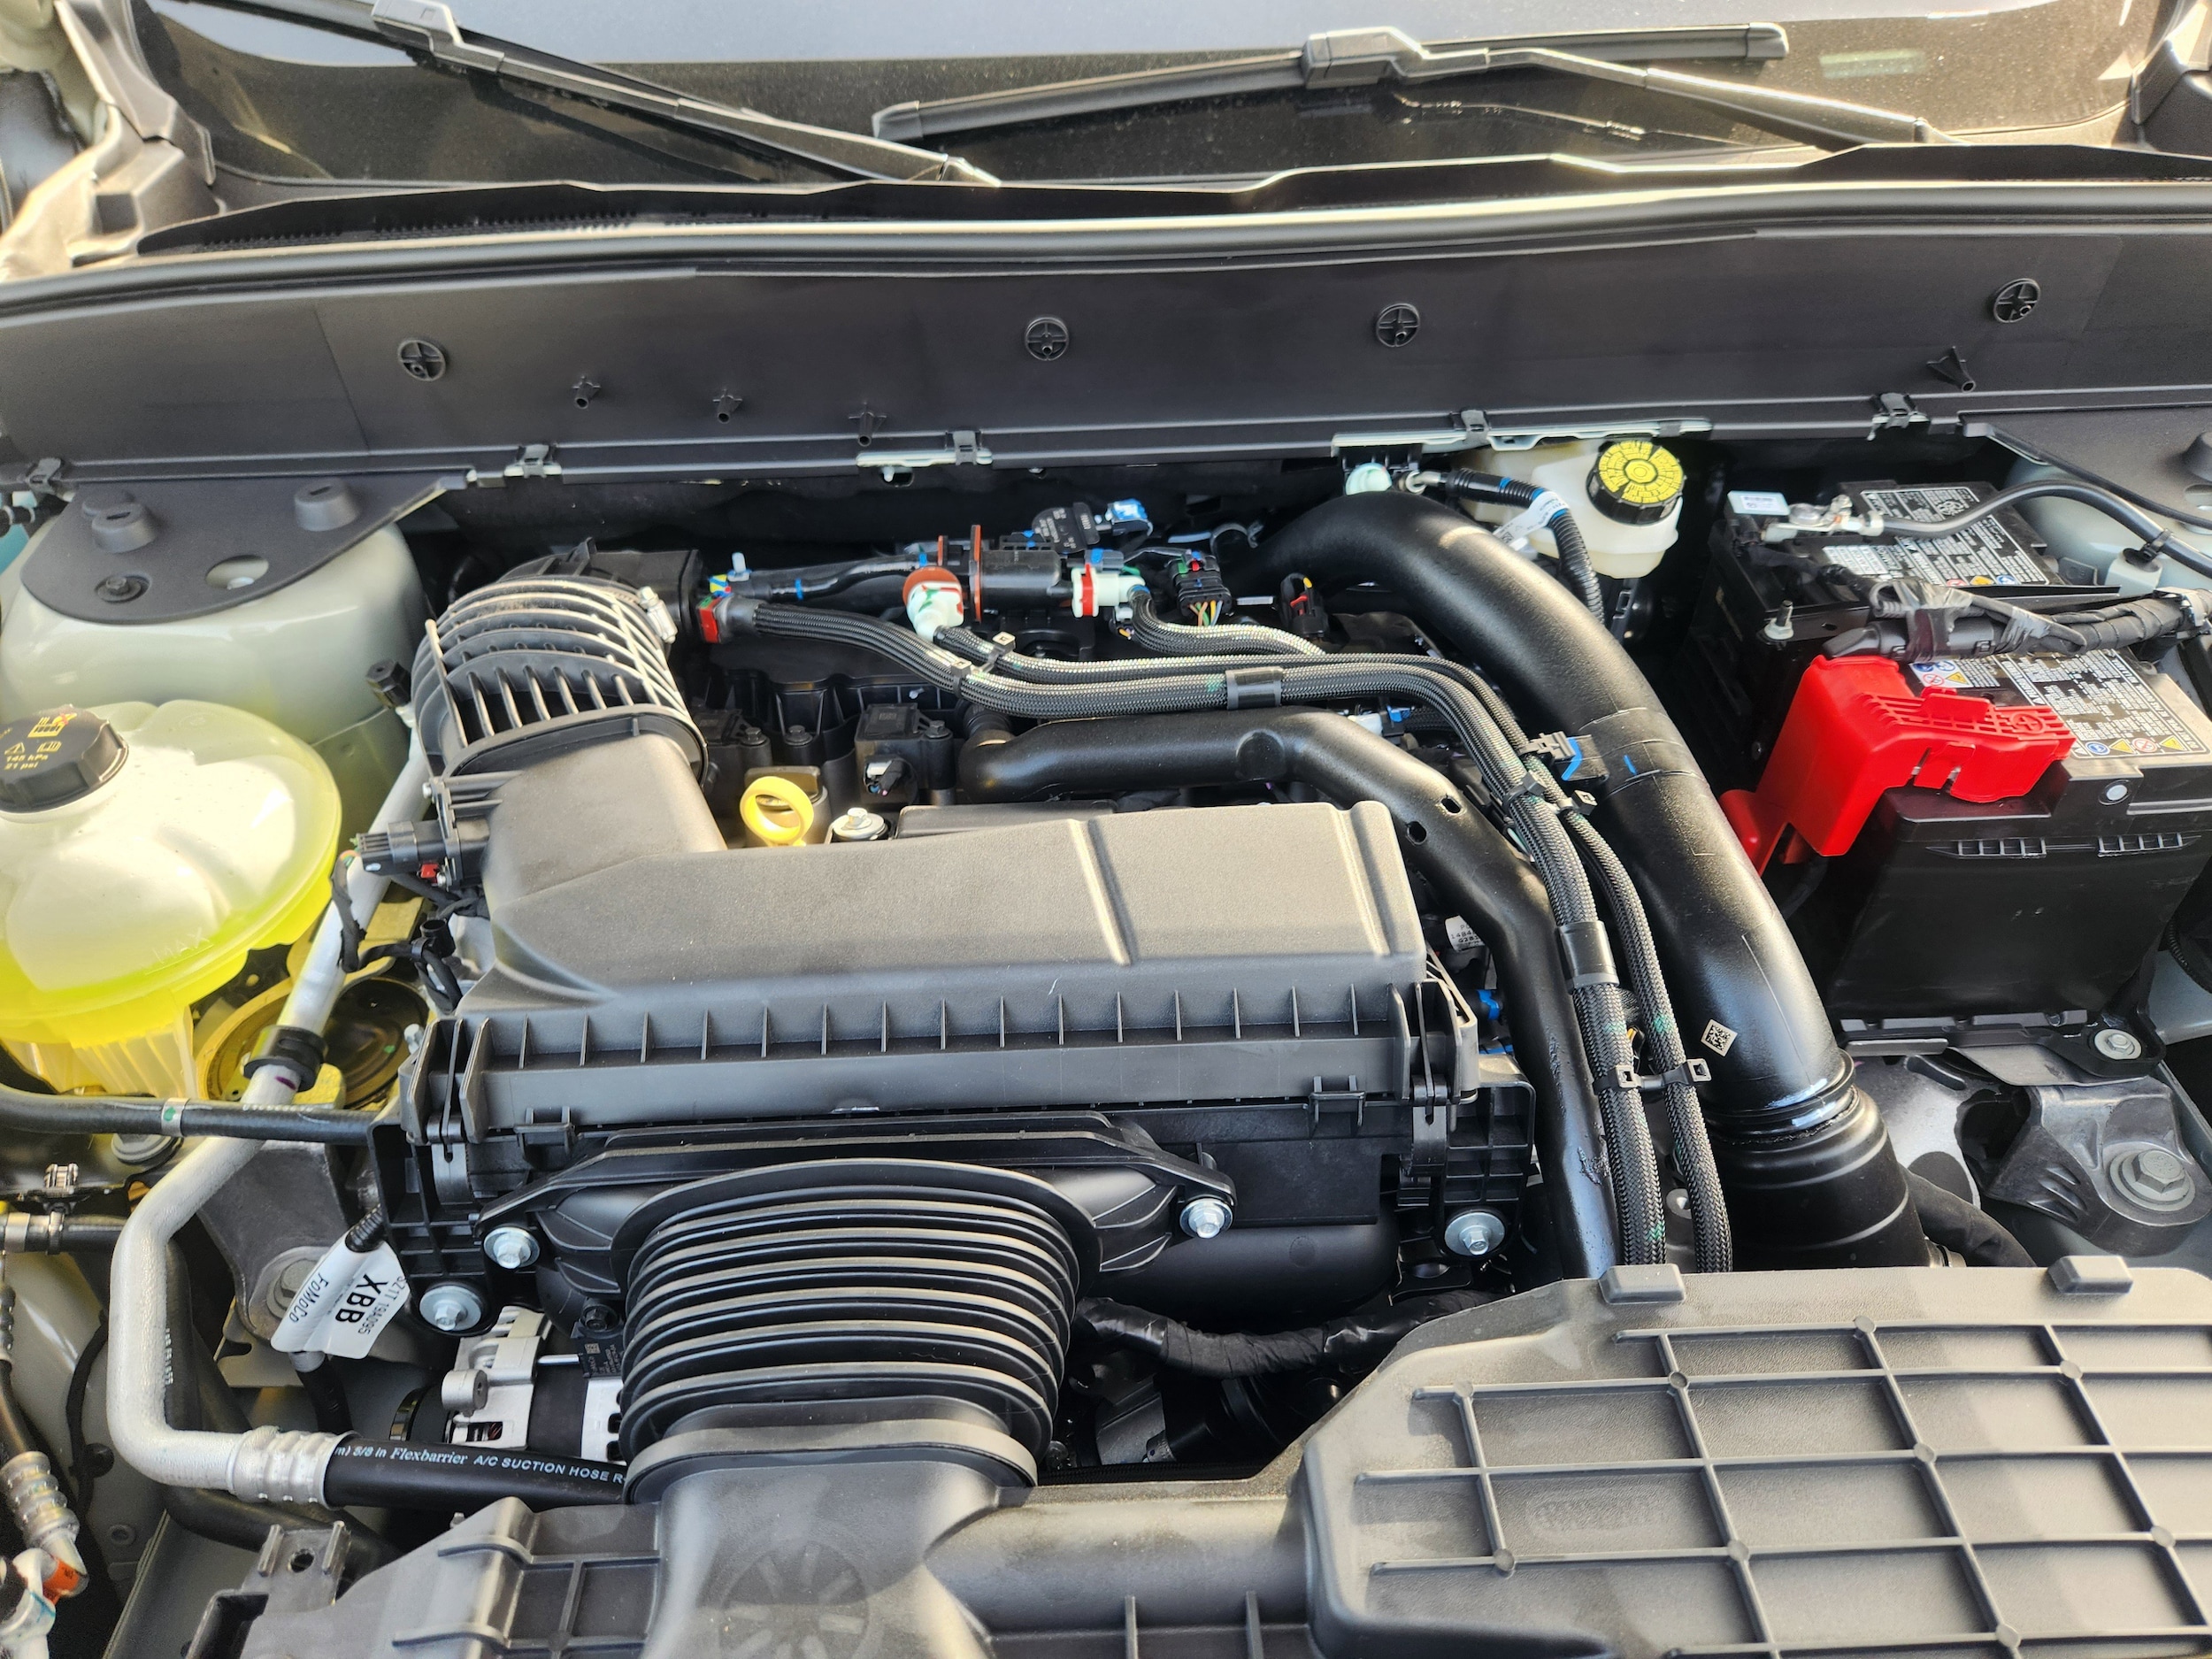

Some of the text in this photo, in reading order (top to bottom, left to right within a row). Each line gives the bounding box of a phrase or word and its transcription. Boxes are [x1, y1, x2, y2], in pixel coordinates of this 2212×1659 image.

[19, 761, 39, 770] psi
[335, 1273, 389, 1325] XBB
[352, 1446, 374, 1457] 5/8
[375, 1447, 387, 1458] in
[389, 1448, 468, 1465] Flexbarrier
[473, 1455, 498, 1467] A/C
[501, 1457, 566, 1475] SUCTION
[569, 1467, 610, 1481] HOSE
